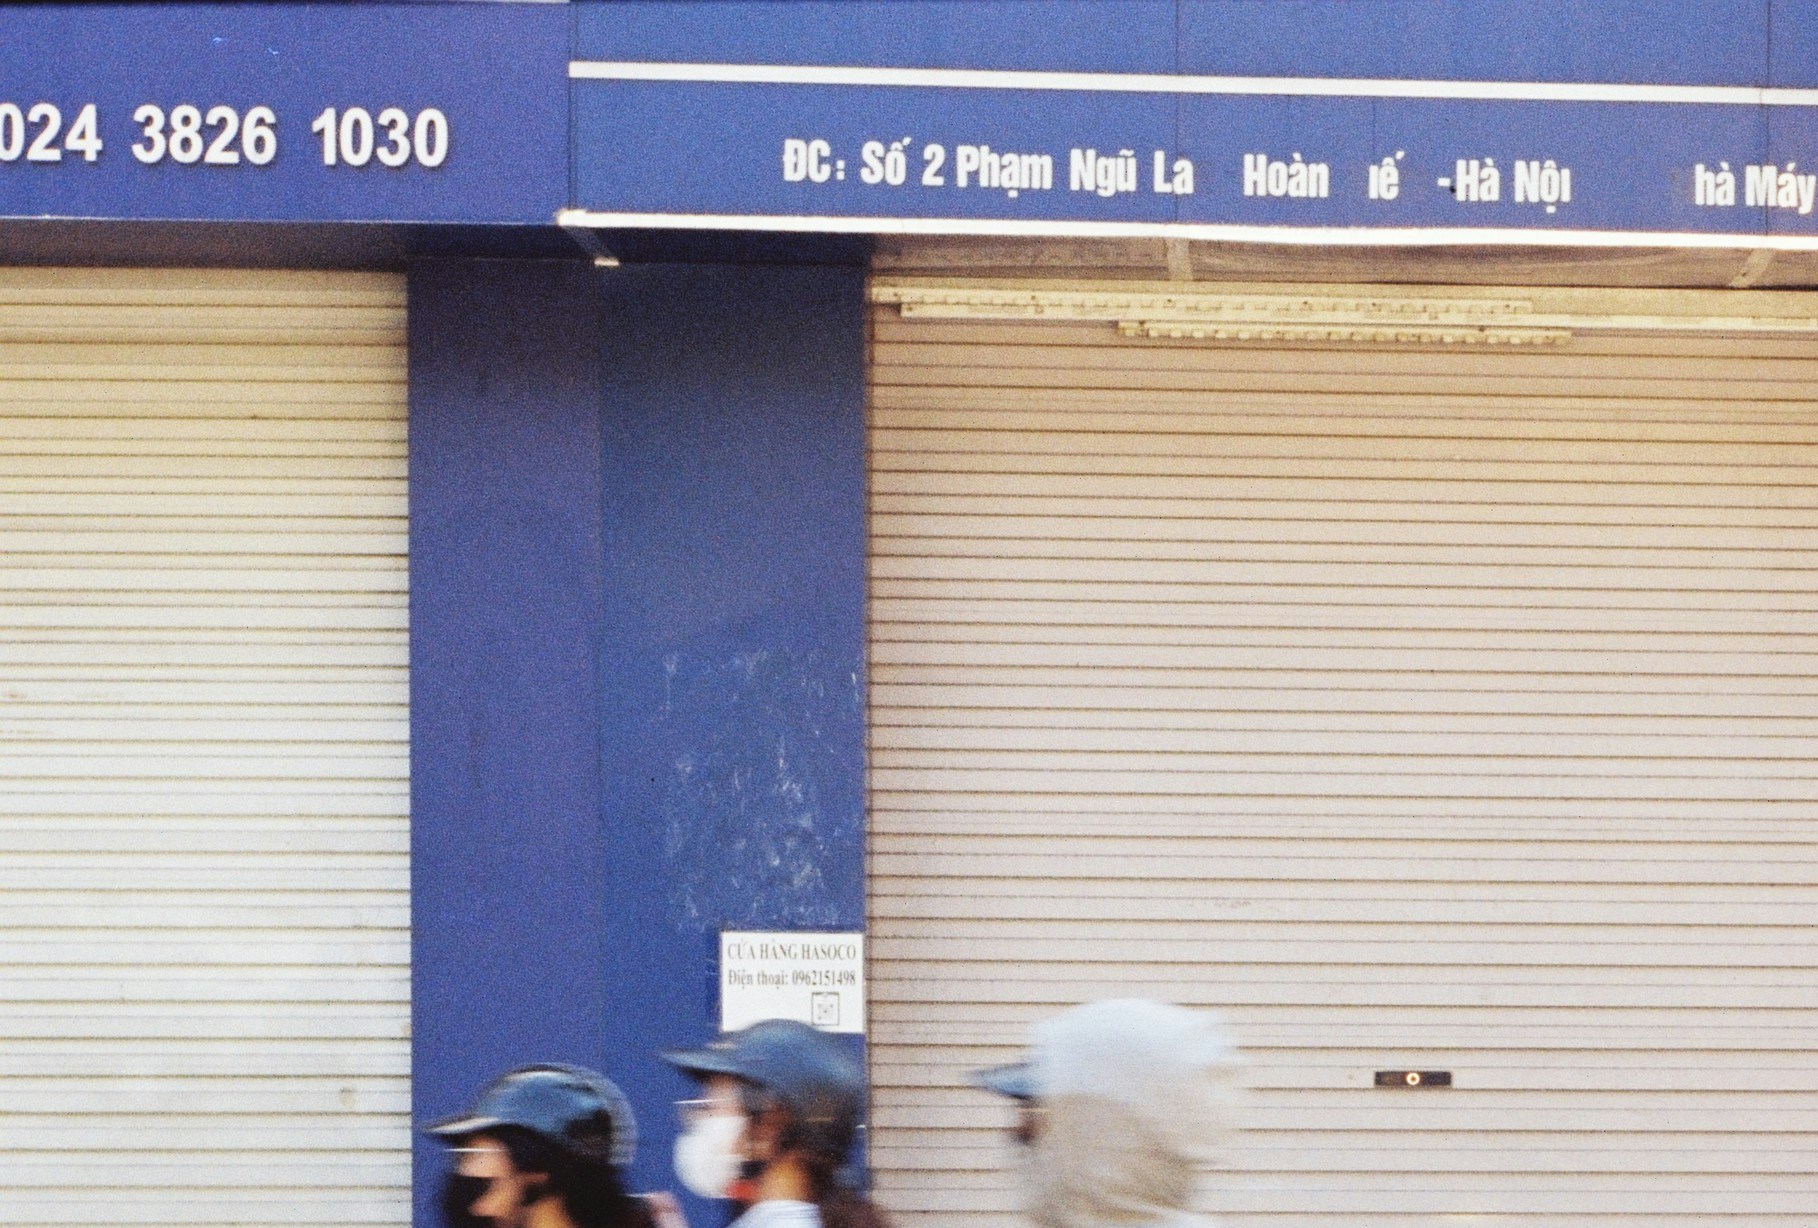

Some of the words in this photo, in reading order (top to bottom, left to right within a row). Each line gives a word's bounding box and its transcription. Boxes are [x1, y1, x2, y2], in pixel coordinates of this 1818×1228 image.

[0, 103, 102, 162] 024
[131, 104, 277, 165] 3826
[311, 107, 449, 168] 1030
[783, 138, 845, 184] ĐC:
[860, 136, 912, 186] Số
[922, 143, 945, 187] 2
[956, 145, 1053, 198] Phạm
[1069, 148, 1137, 198] Ngũ
[1243, 152, 1329, 199] Hoàn
[1745, 162, 1817, 215] Máy
[802, 943, 856, 960] HASOCO
